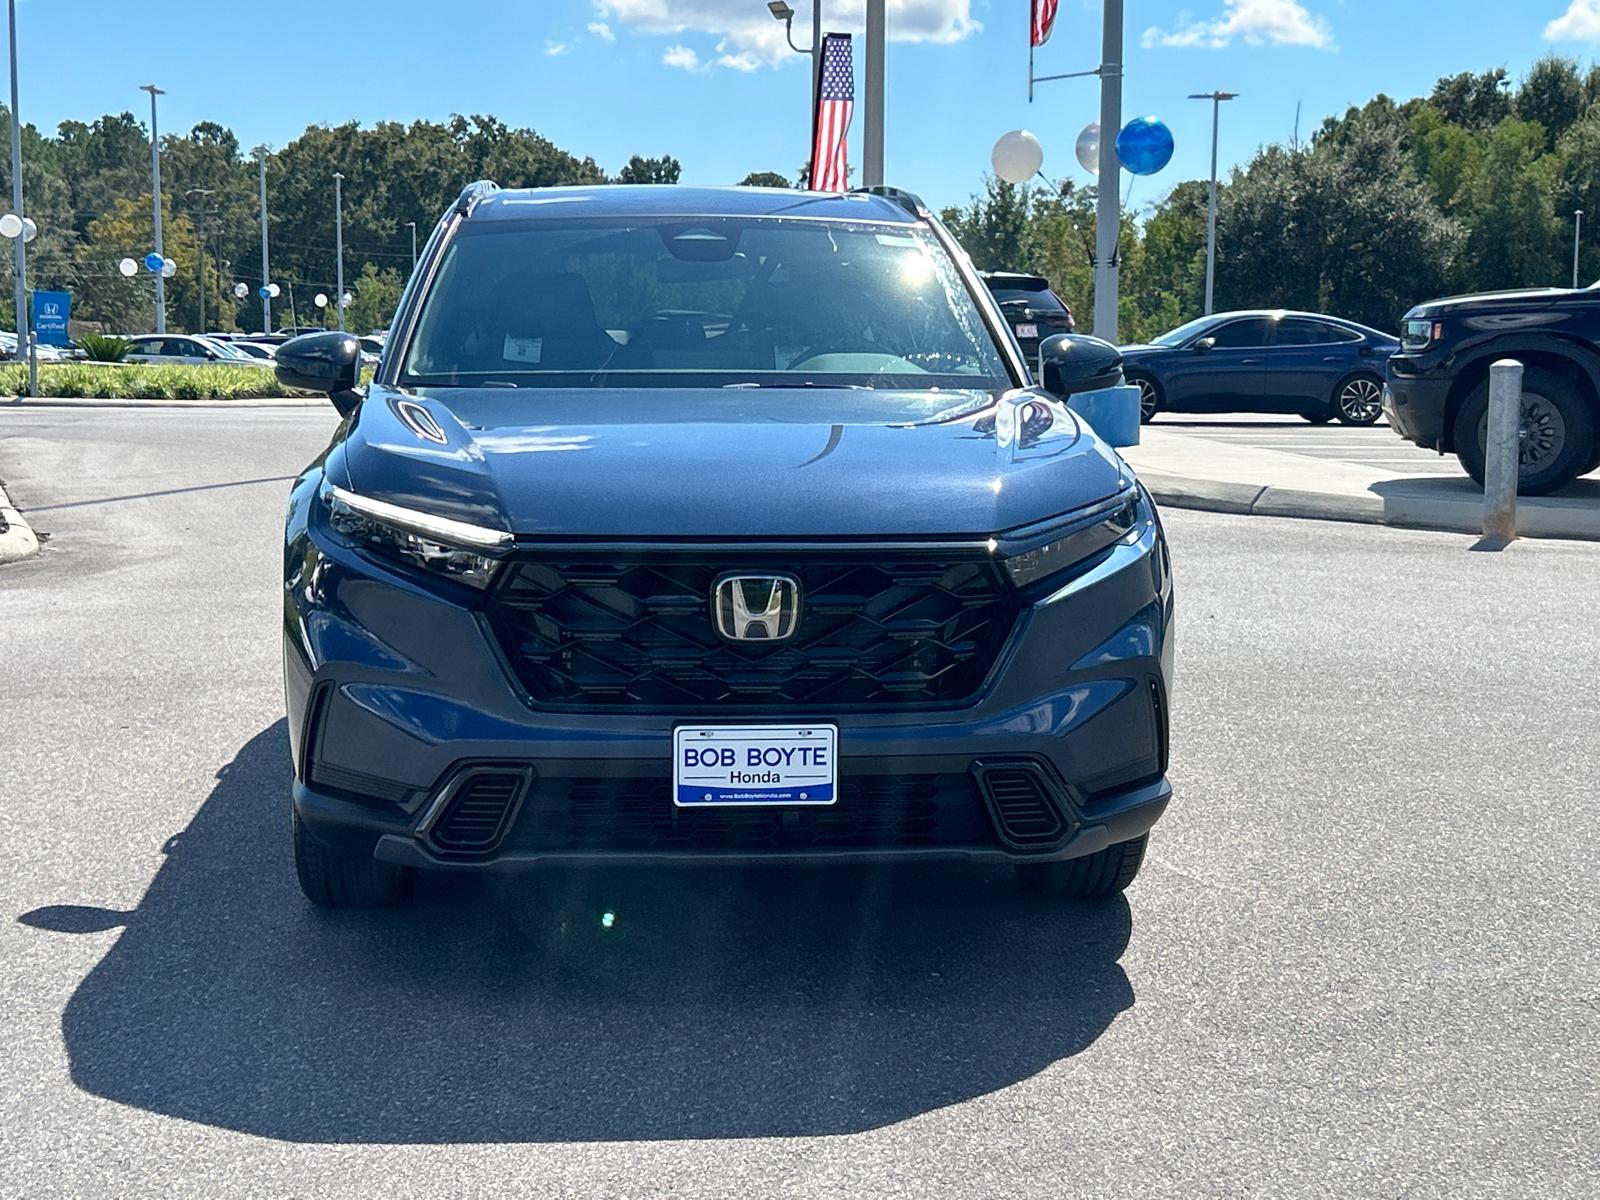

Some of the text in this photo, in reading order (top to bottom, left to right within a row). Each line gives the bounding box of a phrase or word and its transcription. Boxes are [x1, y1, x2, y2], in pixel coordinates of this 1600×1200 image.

[684, 747, 828, 767] BOB BOYTE
[730, 770, 780, 784] Honda
